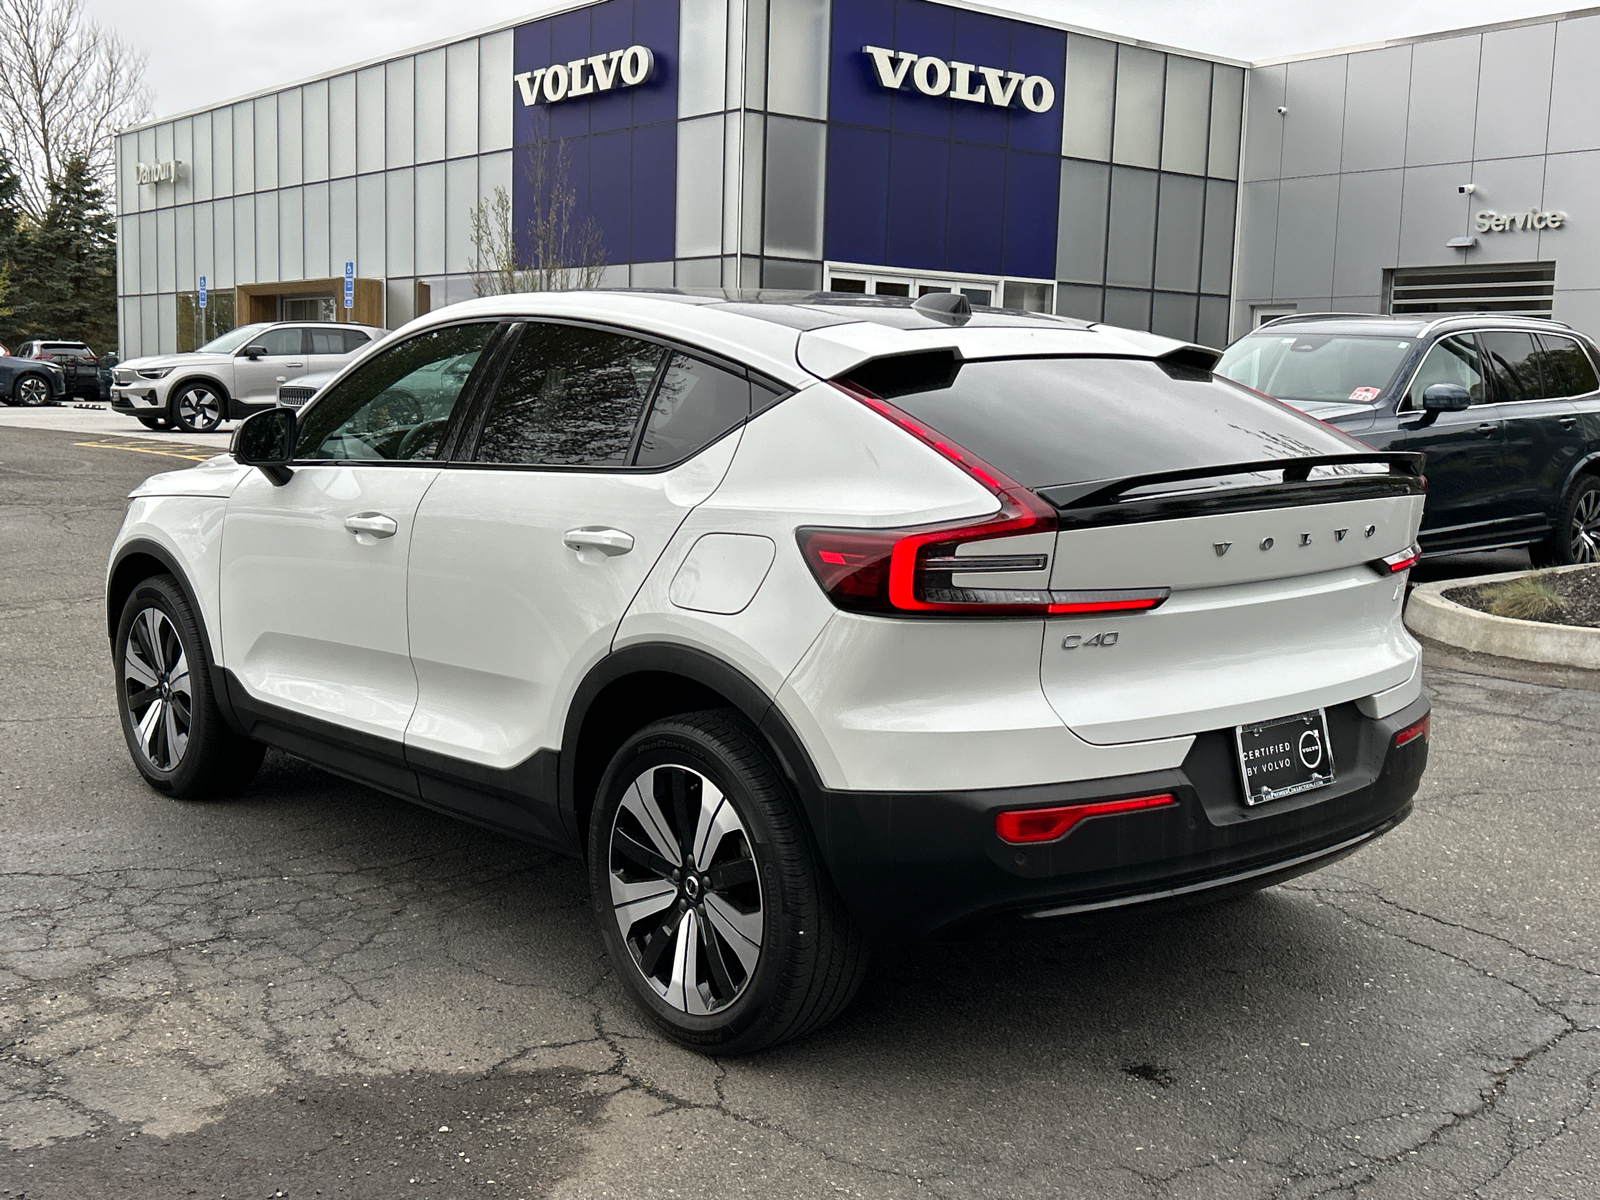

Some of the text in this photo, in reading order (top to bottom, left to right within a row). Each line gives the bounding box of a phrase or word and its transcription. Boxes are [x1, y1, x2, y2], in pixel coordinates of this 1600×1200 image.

[514, 45, 654, 107] VOLVO
[862, 45, 1055, 113] VOLVO
[1474, 207, 1565, 233] Service
[1213, 524, 1376, 557] VOLVO
[1062, 630, 1119, 650] C40
[1242, 742, 1290, 761] CERTIFIED
[1302, 745, 1319, 753] VOLVO
[1247, 758, 1290, 777] BY VOLVO
